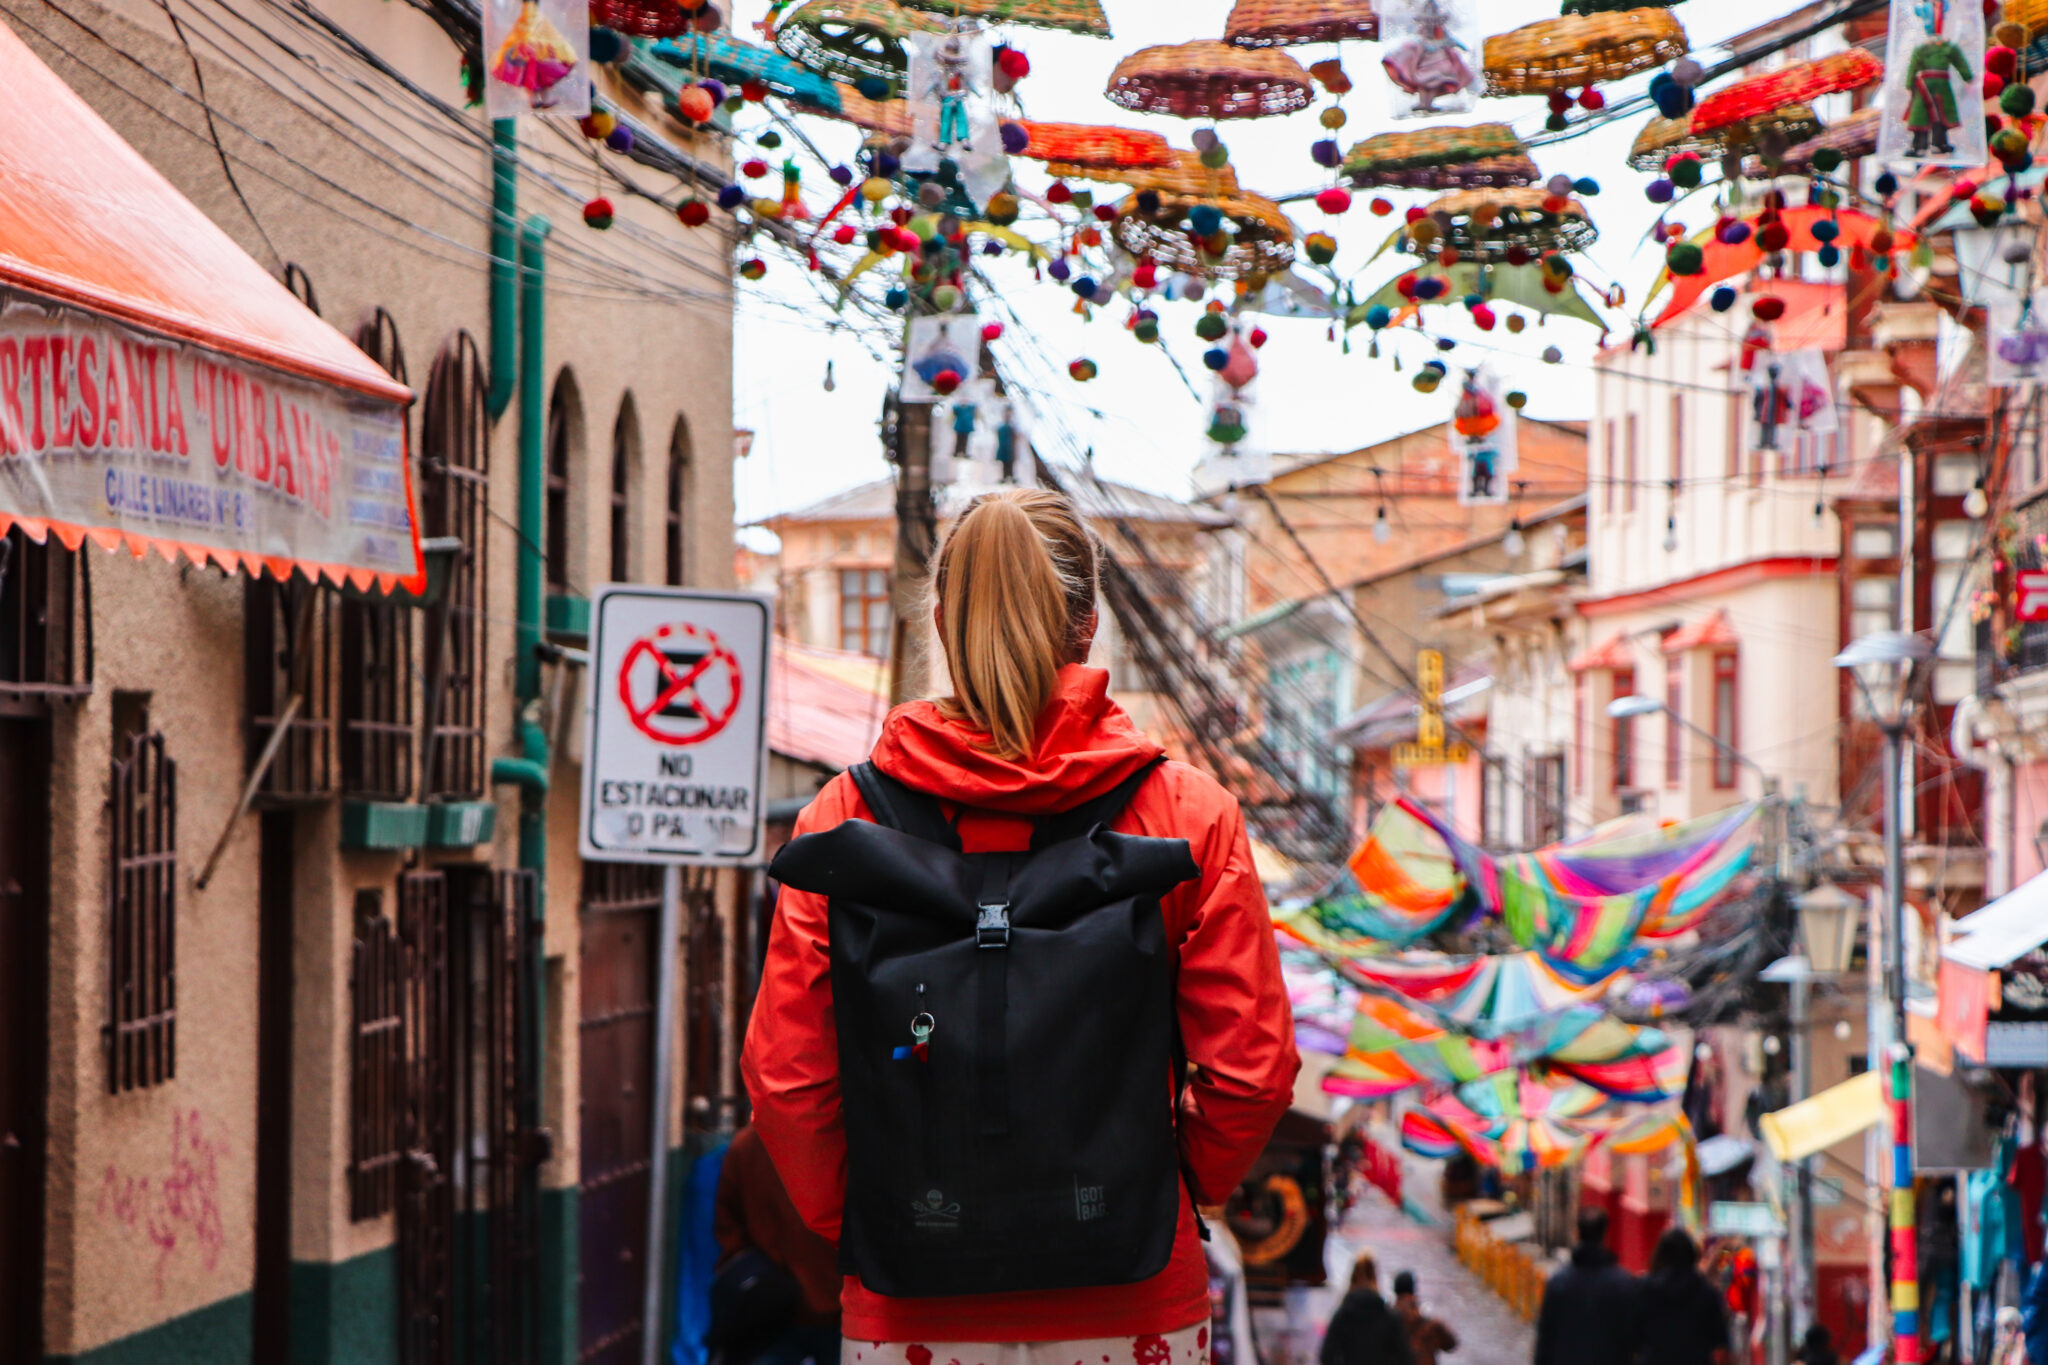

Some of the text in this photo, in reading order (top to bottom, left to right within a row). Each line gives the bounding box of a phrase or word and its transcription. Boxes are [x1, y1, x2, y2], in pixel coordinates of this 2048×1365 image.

[0, 334, 189, 457] RTESANIA
[659, 752, 693, 778] NO
[601, 780, 749, 811] ESTACIONAR
[1080, 1185, 1104, 1203] GOT
